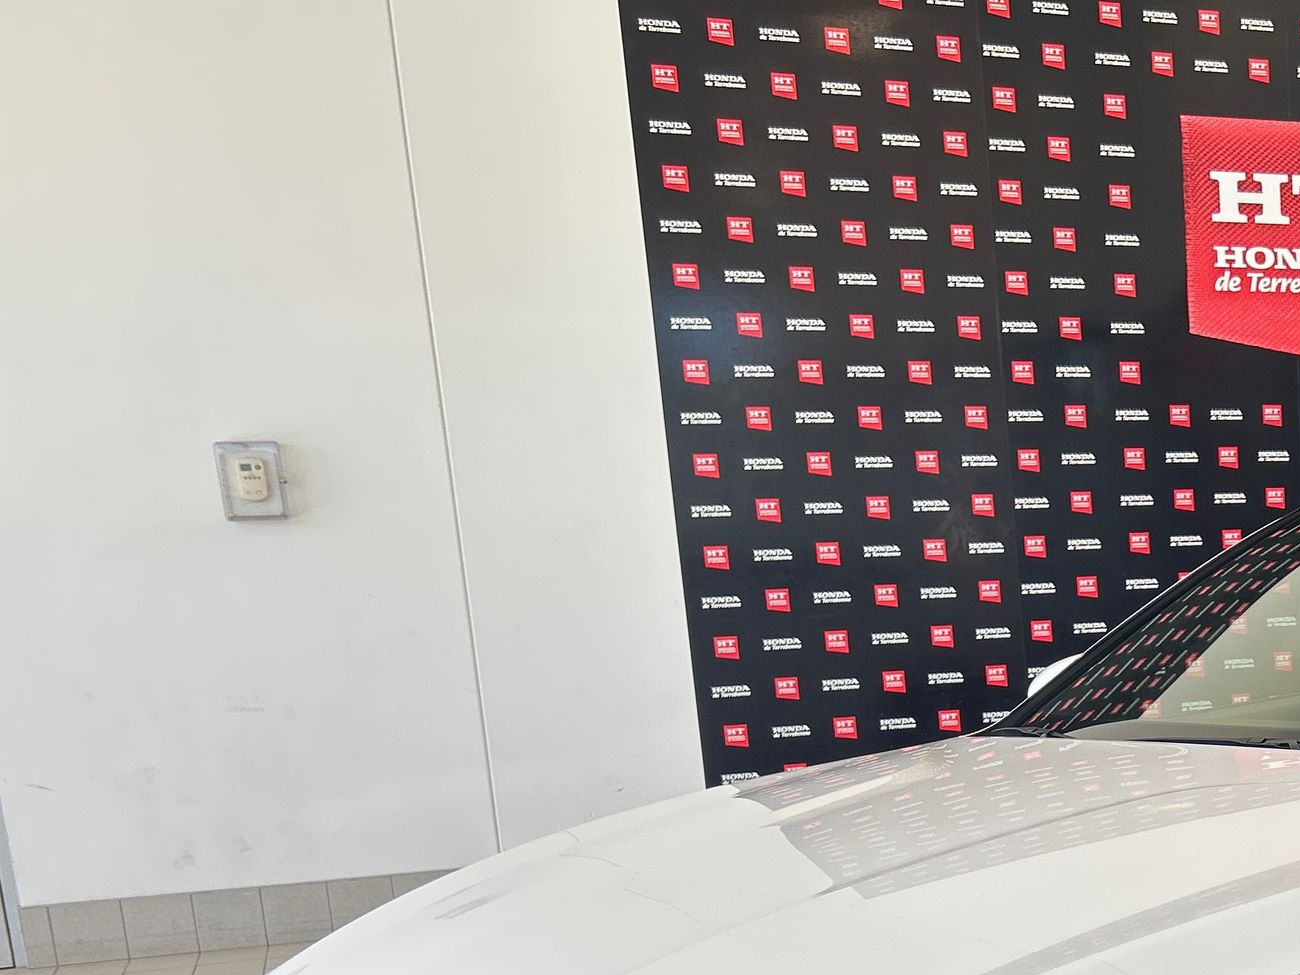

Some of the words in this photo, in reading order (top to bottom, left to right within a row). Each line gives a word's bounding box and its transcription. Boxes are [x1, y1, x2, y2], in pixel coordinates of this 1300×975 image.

[637, 18, 681, 28] HONDA
[758, 27, 800, 37] HONDA
[1045, 47, 1062, 55] HT
[654, 68, 674, 76] HT
[774, 76, 793, 84] HT
[648, 120, 691, 129] HONDA
[836, 129, 854, 137] HT
[665, 169, 685, 177] HT
[659, 219, 702, 228] HONDA
[676, 267, 695, 275] HT
[1215, 271, 1242, 292] de
[670, 316, 712, 325] HONDA
[786, 318, 826, 326] HONDA
[680, 411, 721, 420] HONDA
[690, 504, 731, 513] HONDA
[707, 549, 725, 557] HT
[701, 596, 741, 604] HONDA
